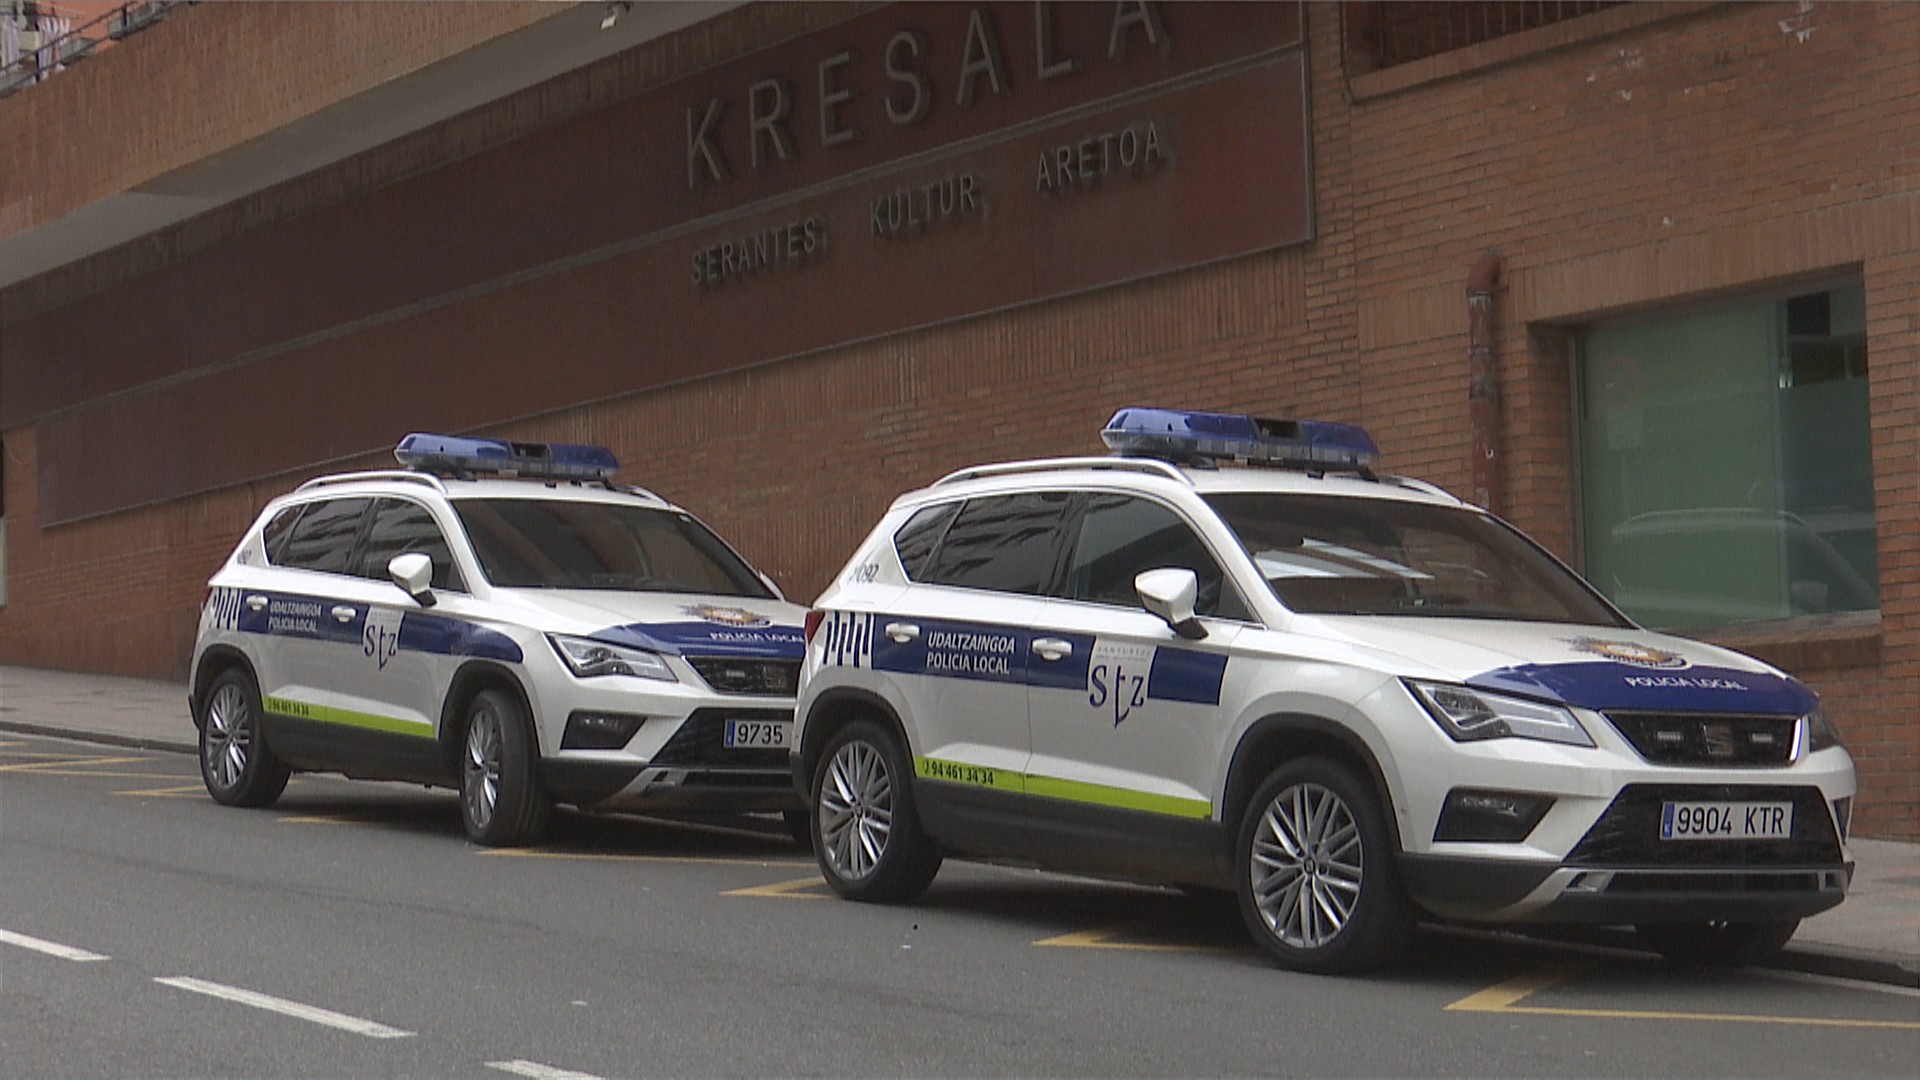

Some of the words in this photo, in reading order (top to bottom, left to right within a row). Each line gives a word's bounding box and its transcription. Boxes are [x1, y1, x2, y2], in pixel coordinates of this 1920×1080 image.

[686, 1, 1159, 188] KRESALA
[691, 218, 817, 284] SERANTES
[870, 174, 976, 237] KULTUR
[1036, 121, 1162, 192] ARETOA
[270, 600, 322, 618] UDALTZAINGOA
[268, 616, 295, 631] POLICIA
[295, 618, 317, 633] LOCAL
[709, 632, 765, 643] POLICIA
[928, 631, 1015, 655] UDALTZAINGOA
[926, 652, 971, 672] POLICIA
[973, 655, 1010, 675] LOCAL
[1624, 676, 1694, 688] POLICIA
[1691, 678, 1749, 691] LOCAL
[1089, 664, 1145, 730] Stz
[737, 723, 783, 745] 9735
[931, 760, 944, 777] 94
[946, 763, 963, 781] 461
[966, 767, 979, 783] 34
[981, 771, 994, 786] 34
[1677, 806, 1732, 835] 9904
[1744, 806, 1785, 835] KTR
